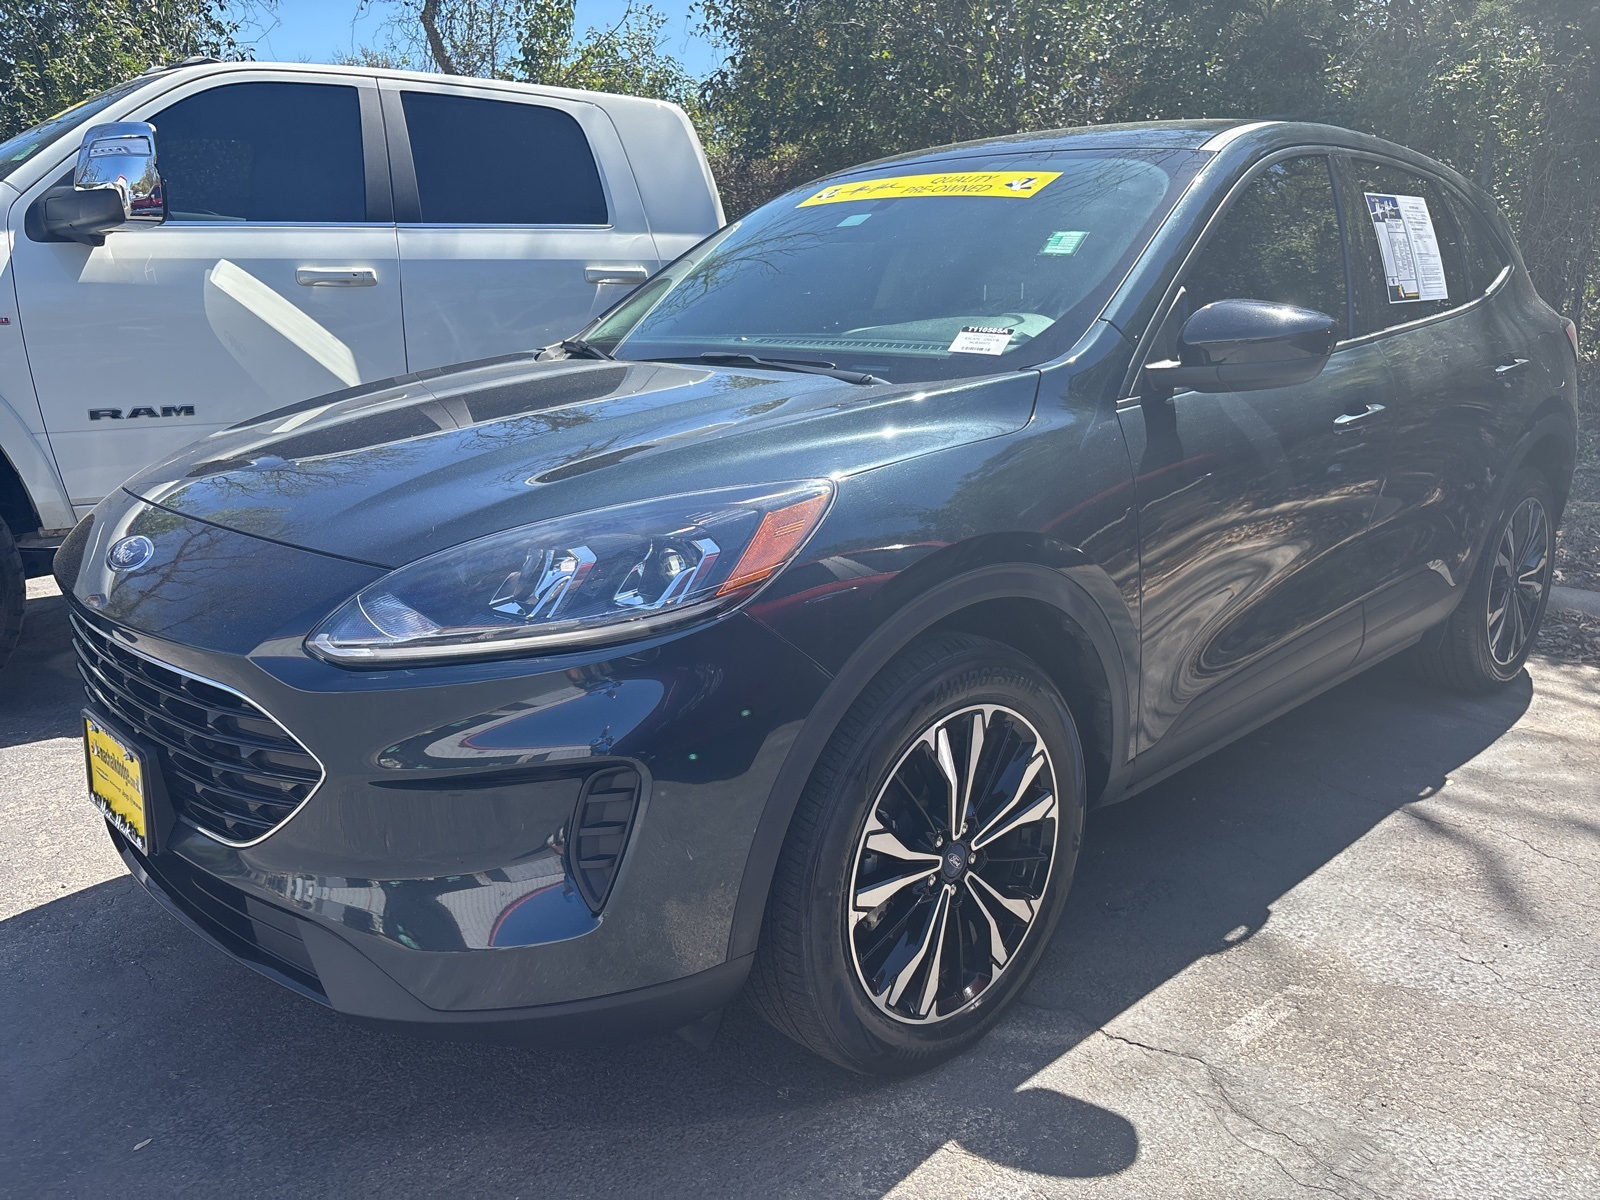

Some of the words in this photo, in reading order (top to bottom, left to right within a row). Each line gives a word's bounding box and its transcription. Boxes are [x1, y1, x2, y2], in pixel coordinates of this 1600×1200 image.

[931, 174, 1000, 185] QUALITY
[900, 184, 993, 195] PRE-OWNED
[88, 404, 196, 421] RAM
[934, 666, 1041, 703] BRIDGESTONE
